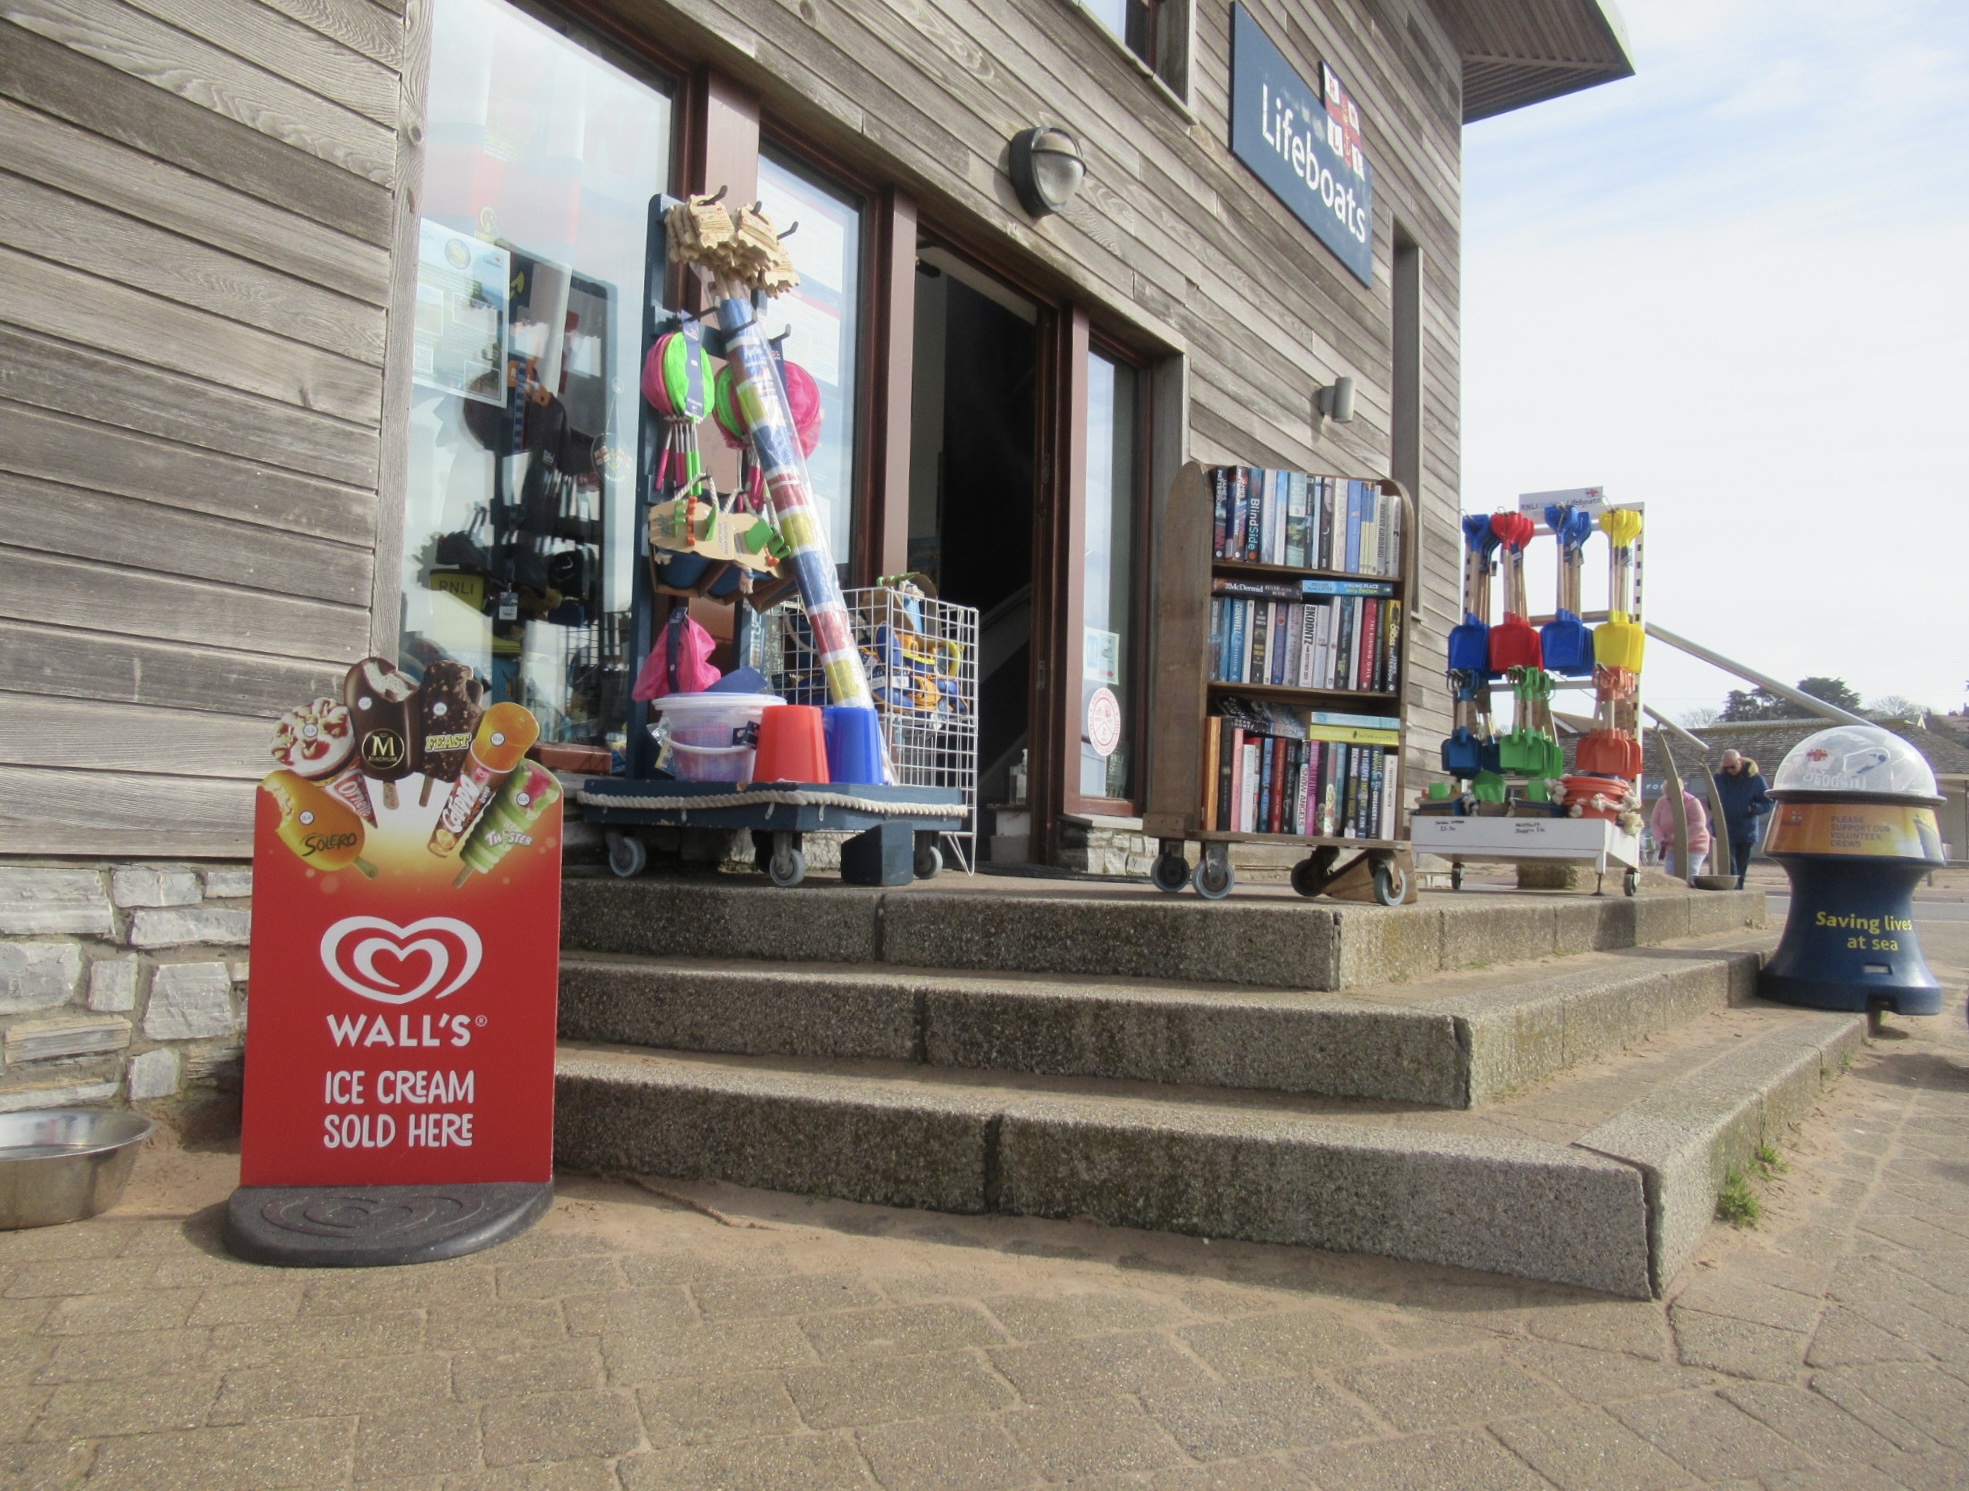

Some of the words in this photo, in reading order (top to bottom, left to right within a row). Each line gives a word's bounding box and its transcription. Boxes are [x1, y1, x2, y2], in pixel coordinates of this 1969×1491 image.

[1262, 83, 1365, 243] Lifeboats
[439, 580, 474, 595] RNLI
[1303, 611, 1315, 646] KOONTZ
[425, 732, 472, 753] FEAST
[368, 755, 398, 763] MAGNUM
[1350, 747, 1359, 777] BECOMING
[1300, 768, 1308, 794] SNOW
[1298, 794, 1306, 827] ANGELS
[1831, 815, 1865, 823] PLEASE
[1831, 824, 1870, 832] SUPPORT
[1873, 825, 1891, 833] OUR
[1831, 832, 1882, 841] VOLUNTEER
[302, 832, 358, 857] SOLERO
[1831, 839, 1862, 848] CREWS
[1816, 911, 1880, 935] Saving
[1884, 915, 1913, 931] lives
[1847, 936, 1867, 950] at
[1871, 938, 1899, 951] sea
[325, 1012, 471, 1048] WALL'S
[324, 1070, 366, 1105] ICE
[376, 1069, 474, 1105] CREAM
[323, 1113, 397, 1149] SOLD
[408, 1113, 473, 1149] HERE
